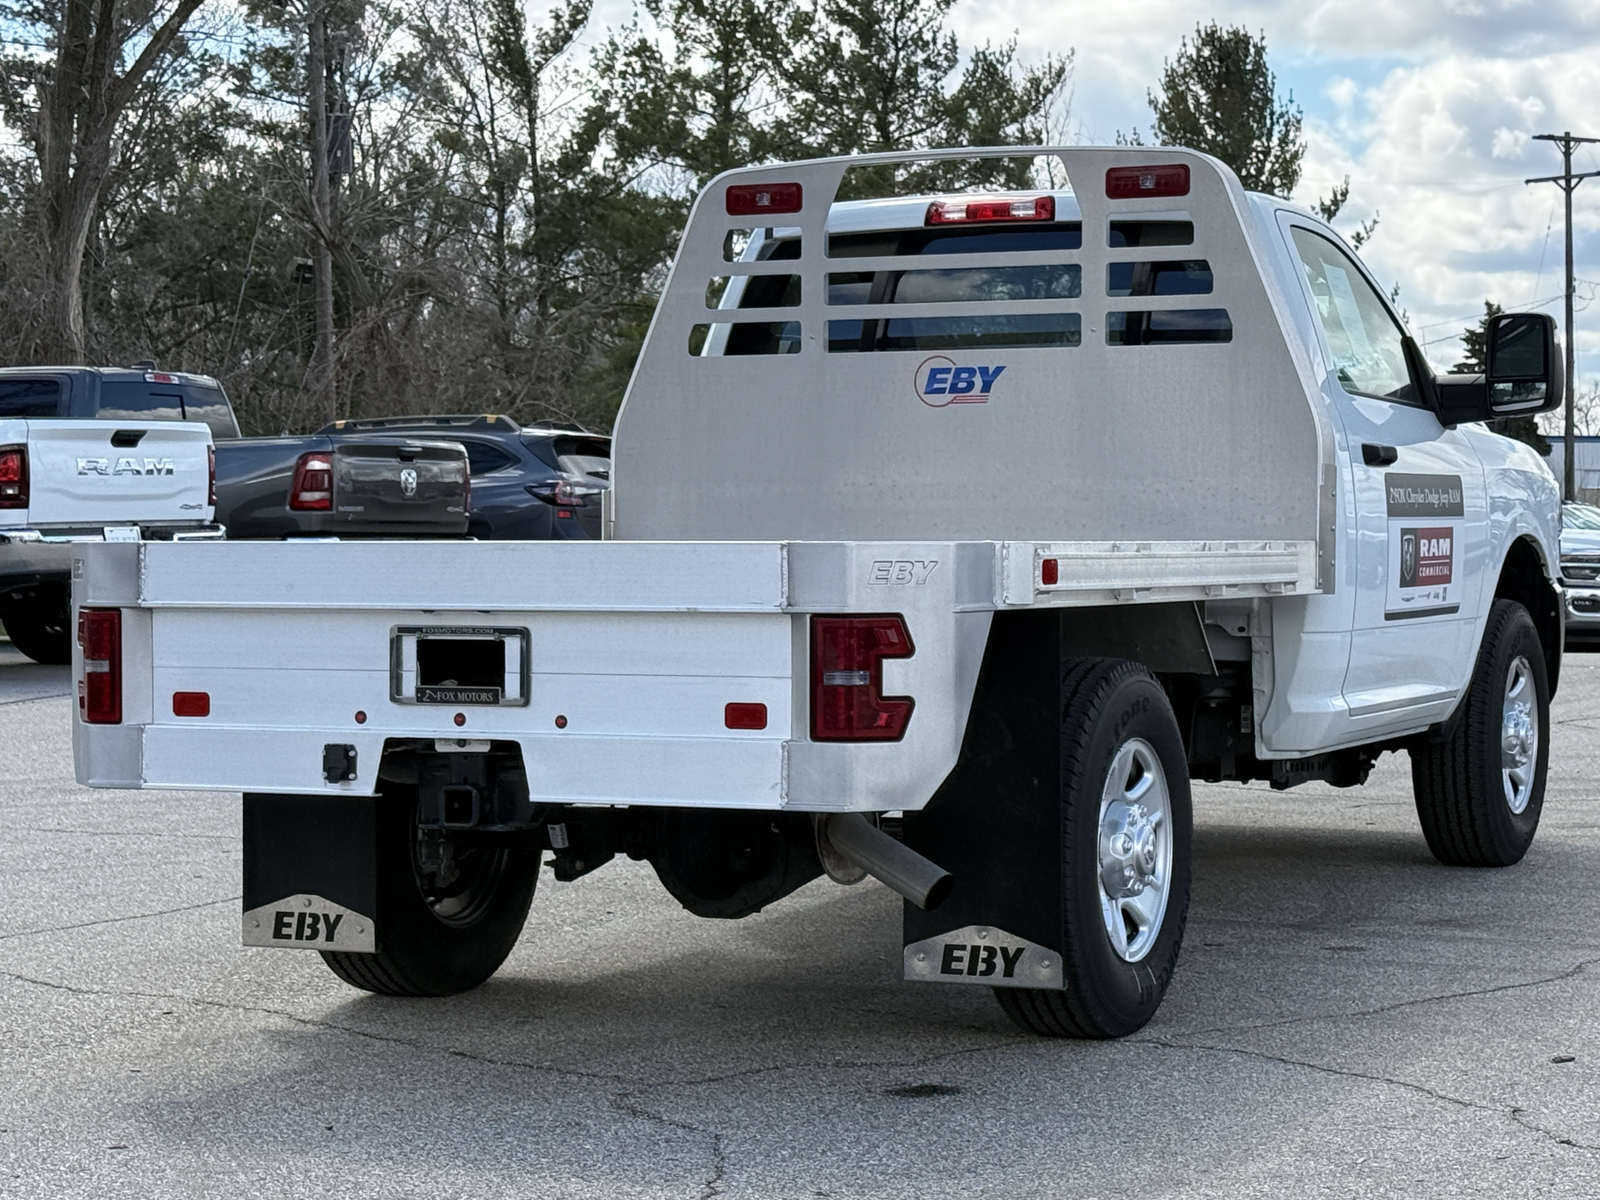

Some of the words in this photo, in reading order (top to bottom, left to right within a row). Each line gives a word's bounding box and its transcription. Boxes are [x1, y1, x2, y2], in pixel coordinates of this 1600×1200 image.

[923, 365, 1007, 395] EBY
[77, 457, 174, 476] RAM
[1406, 488, 1424, 508] Chrysler
[1424, 488, 1439, 508] Dodge
[1439, 488, 1448, 508] Jeep
[1448, 489, 1461, 503] RAM
[1420, 538, 1450, 557] RAM
[868, 560, 938, 585] EBY
[1419, 565, 1450, 577] COMMERCIAL
[437, 691, 455, 700] FOX
[457, 692, 493, 701] MOTORS
[272, 911, 344, 942] EBY
[940, 943, 1025, 978] EBY
